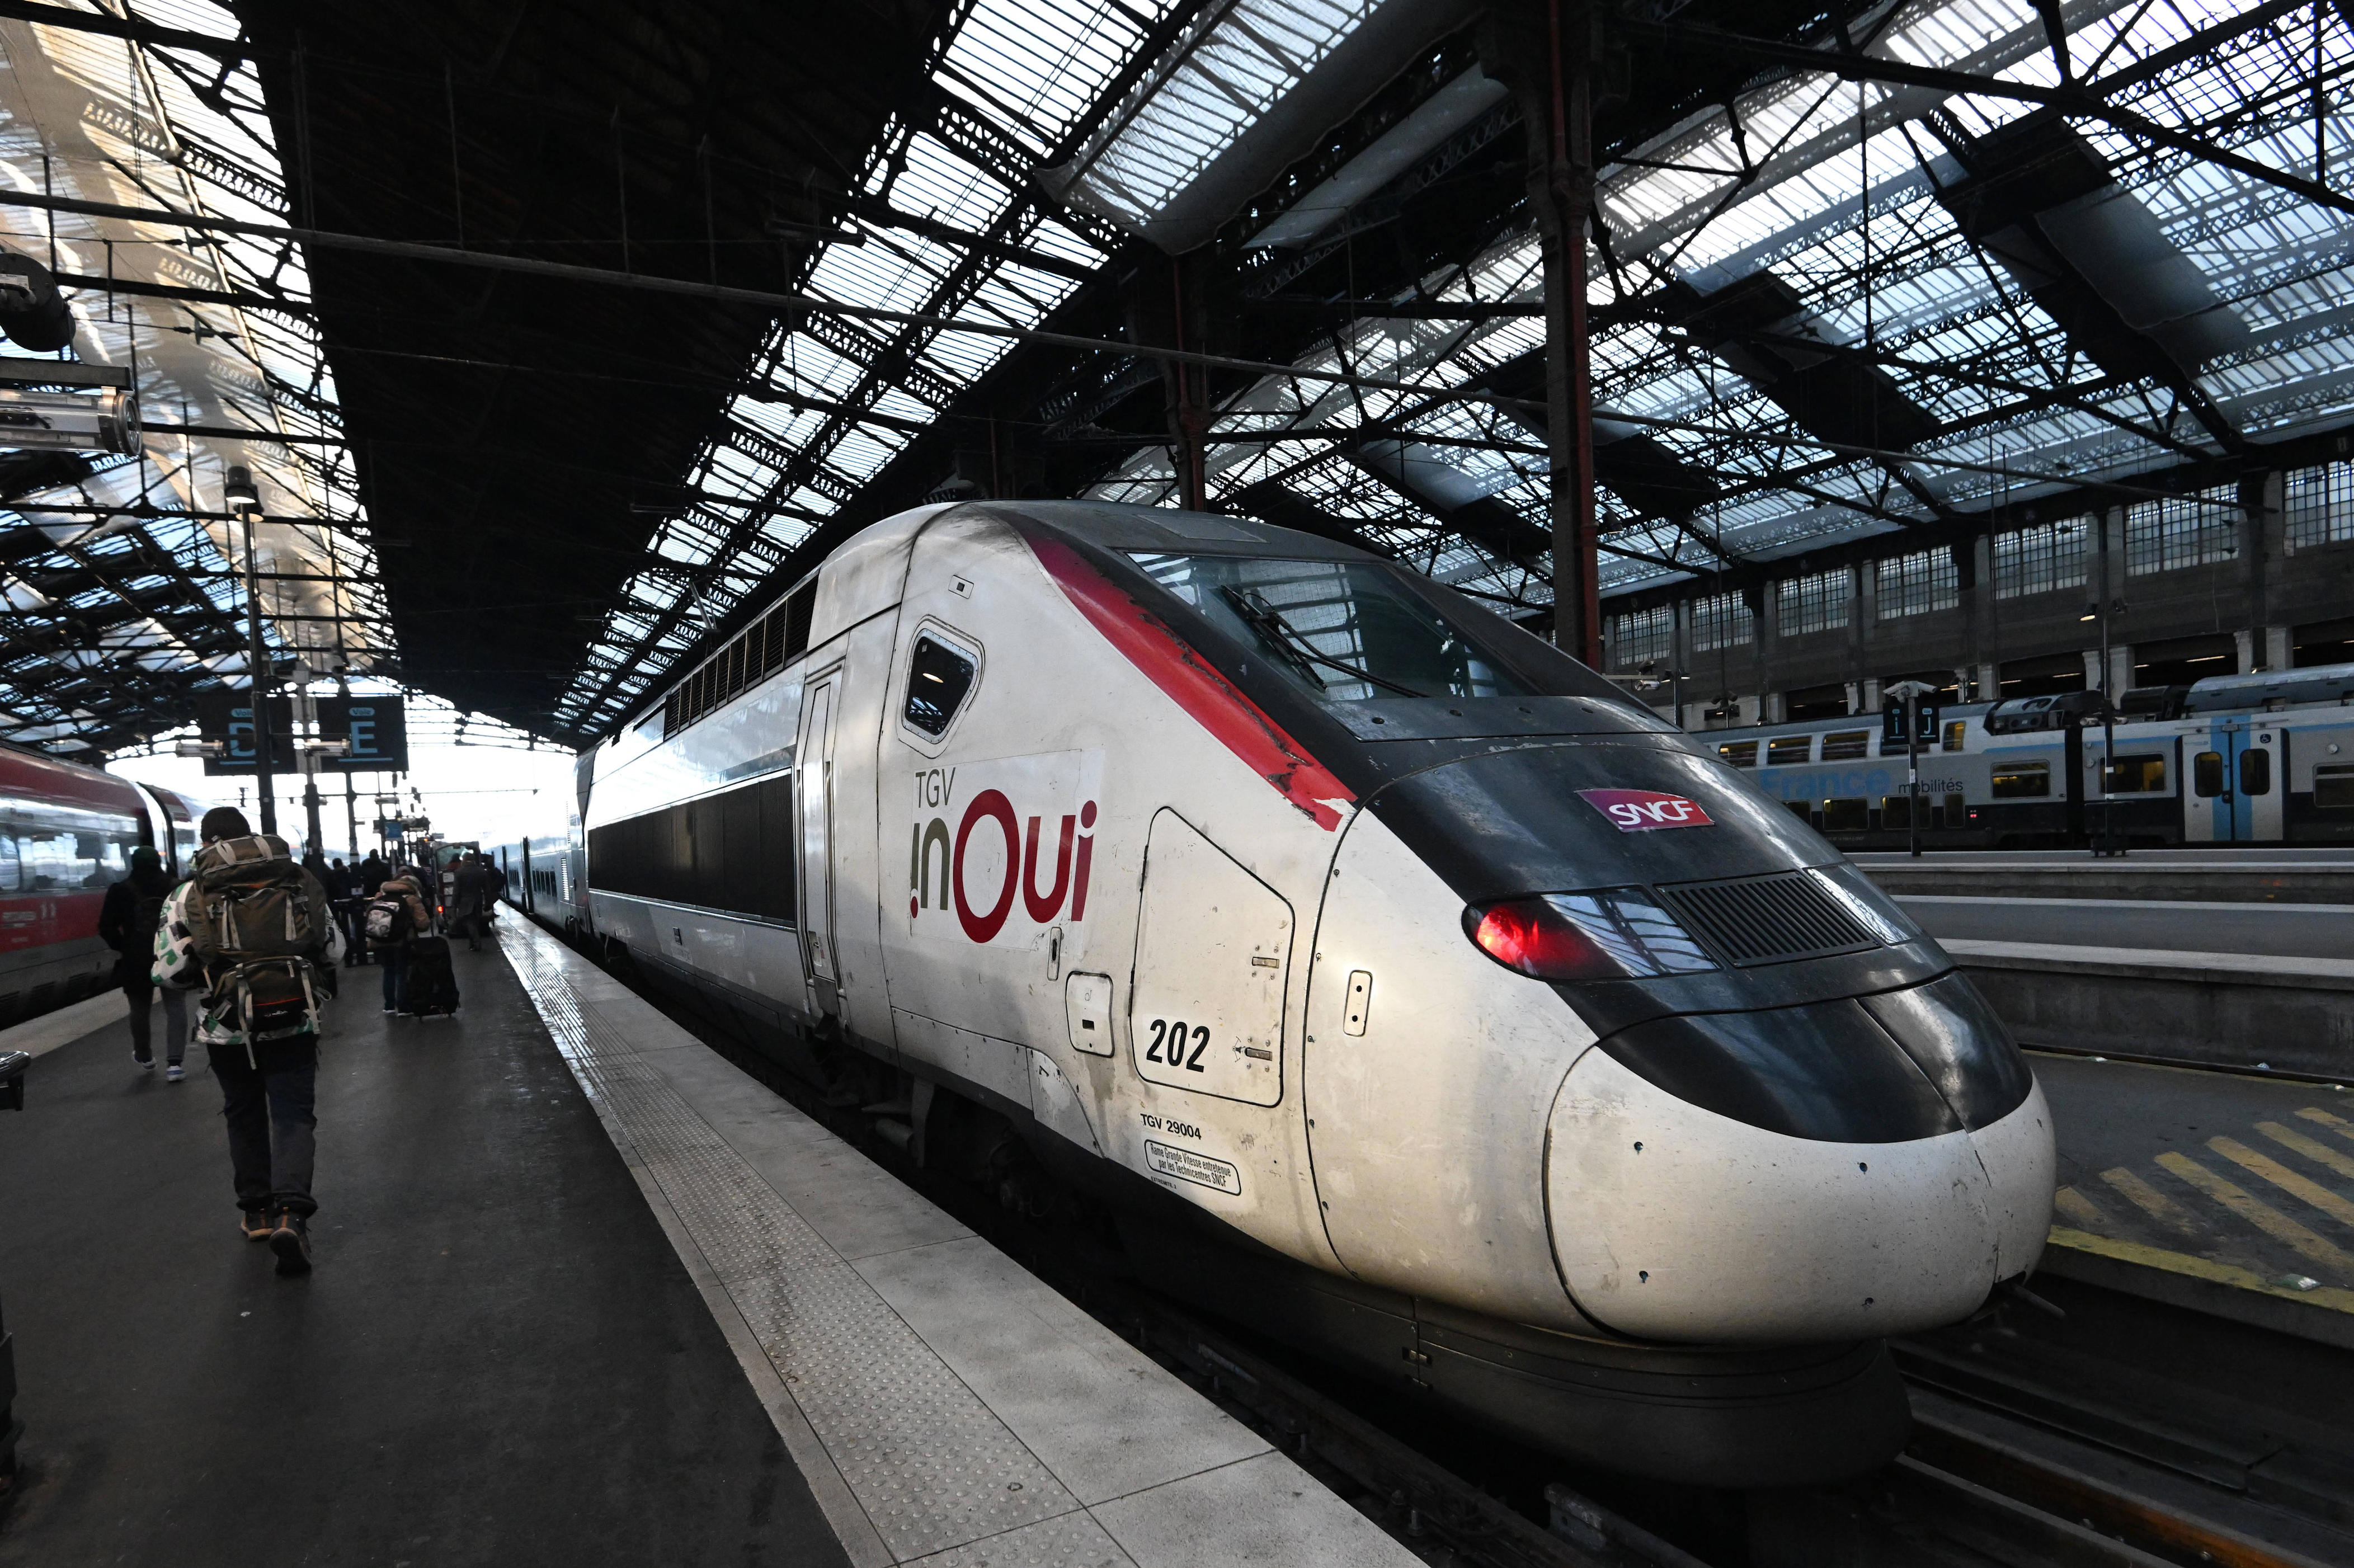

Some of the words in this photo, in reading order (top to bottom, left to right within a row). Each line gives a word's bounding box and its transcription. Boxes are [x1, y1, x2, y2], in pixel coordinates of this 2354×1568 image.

[350, 721, 379, 754] E
[1923, 717, 1931, 734] J
[915, 767, 956, 808] TGV
[1759, 768, 1891, 799] France
[1898, 777, 1964, 794] mbilités
[1609, 801, 1693, 825] SNCF
[1146, 1019, 1211, 1073] 202
[1140, 1113, 1162, 1129] TGV
[1166, 1120, 1202, 1140] 29004
[1150, 1143, 1164, 1157] Rame
[1164, 1147, 1183, 1163] Grande
[1182, 1152, 1202, 1169] Vitesse
[1202, 1161, 1231, 1177] entretenue
[1159, 1159, 1167, 1171] par
[1166, 1159, 1175, 1172] les
[1174, 1161, 1212, 1183] Technicentres
[1211, 1172, 1226, 1187] SNCF
